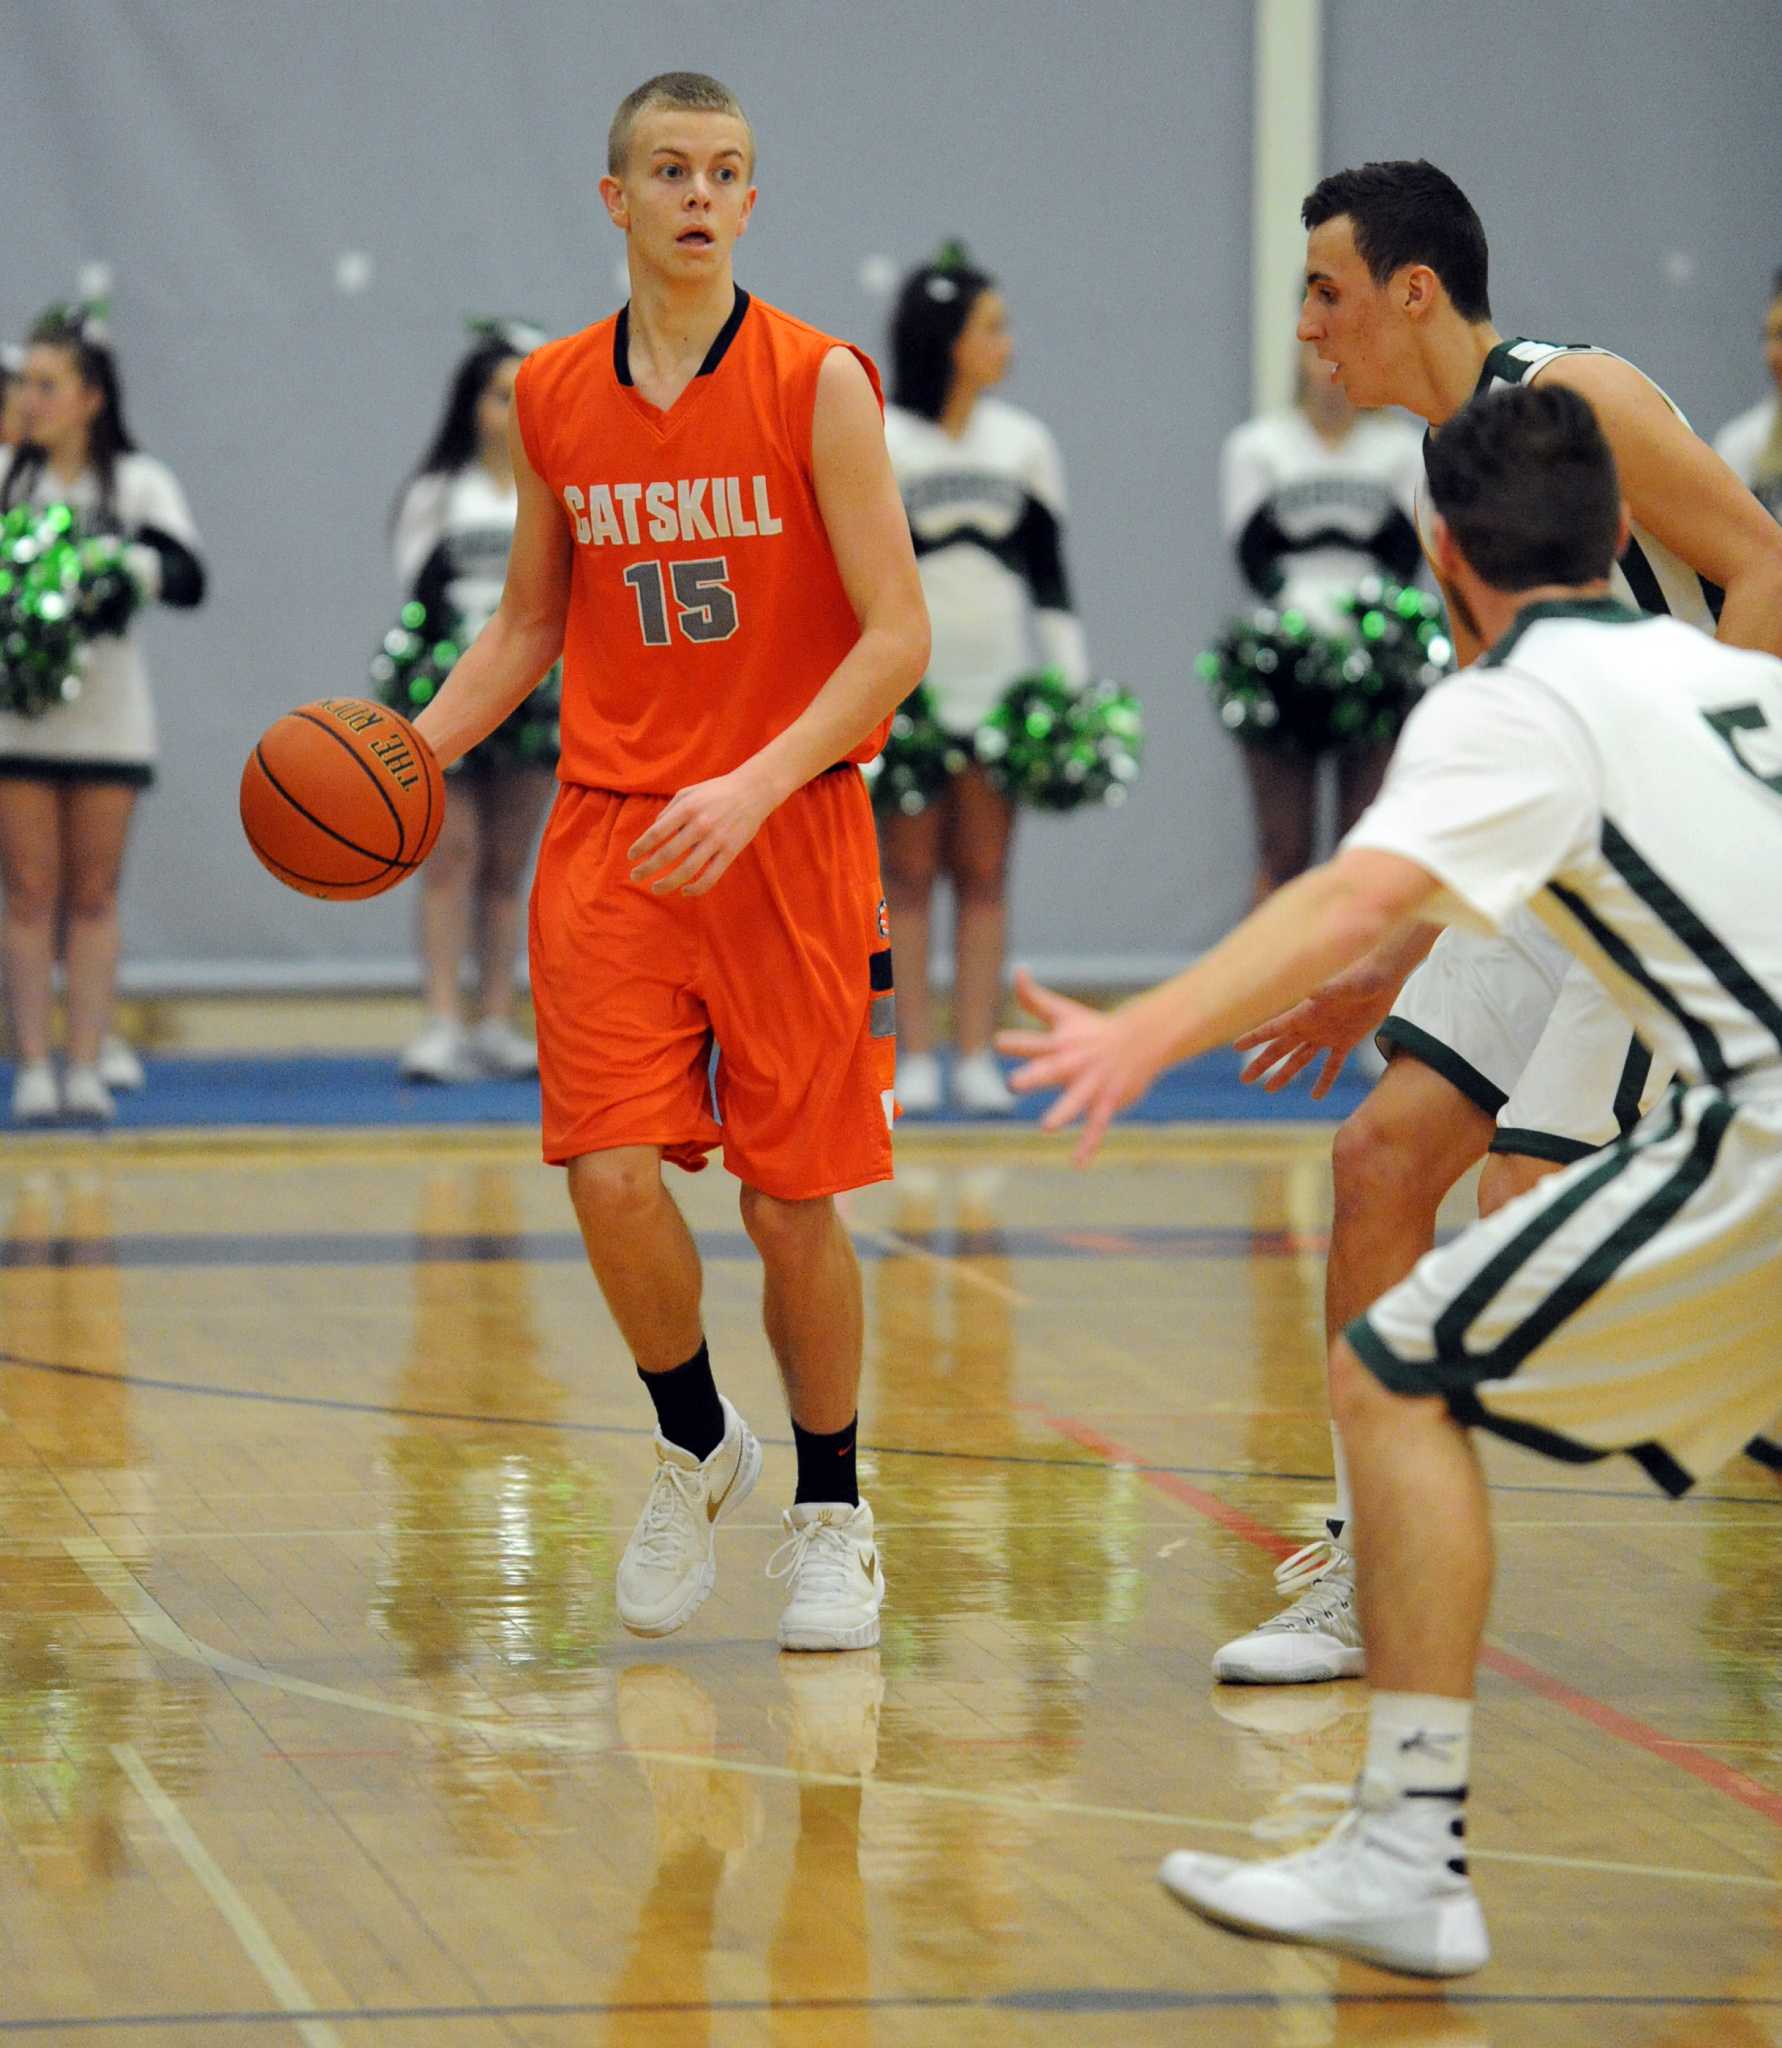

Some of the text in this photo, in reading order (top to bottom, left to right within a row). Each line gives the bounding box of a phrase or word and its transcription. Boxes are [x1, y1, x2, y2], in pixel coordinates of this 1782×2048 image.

[563, 475, 783, 546] CATSKILL
[623, 556, 740, 646] 15
[368, 733, 419, 792] THE
